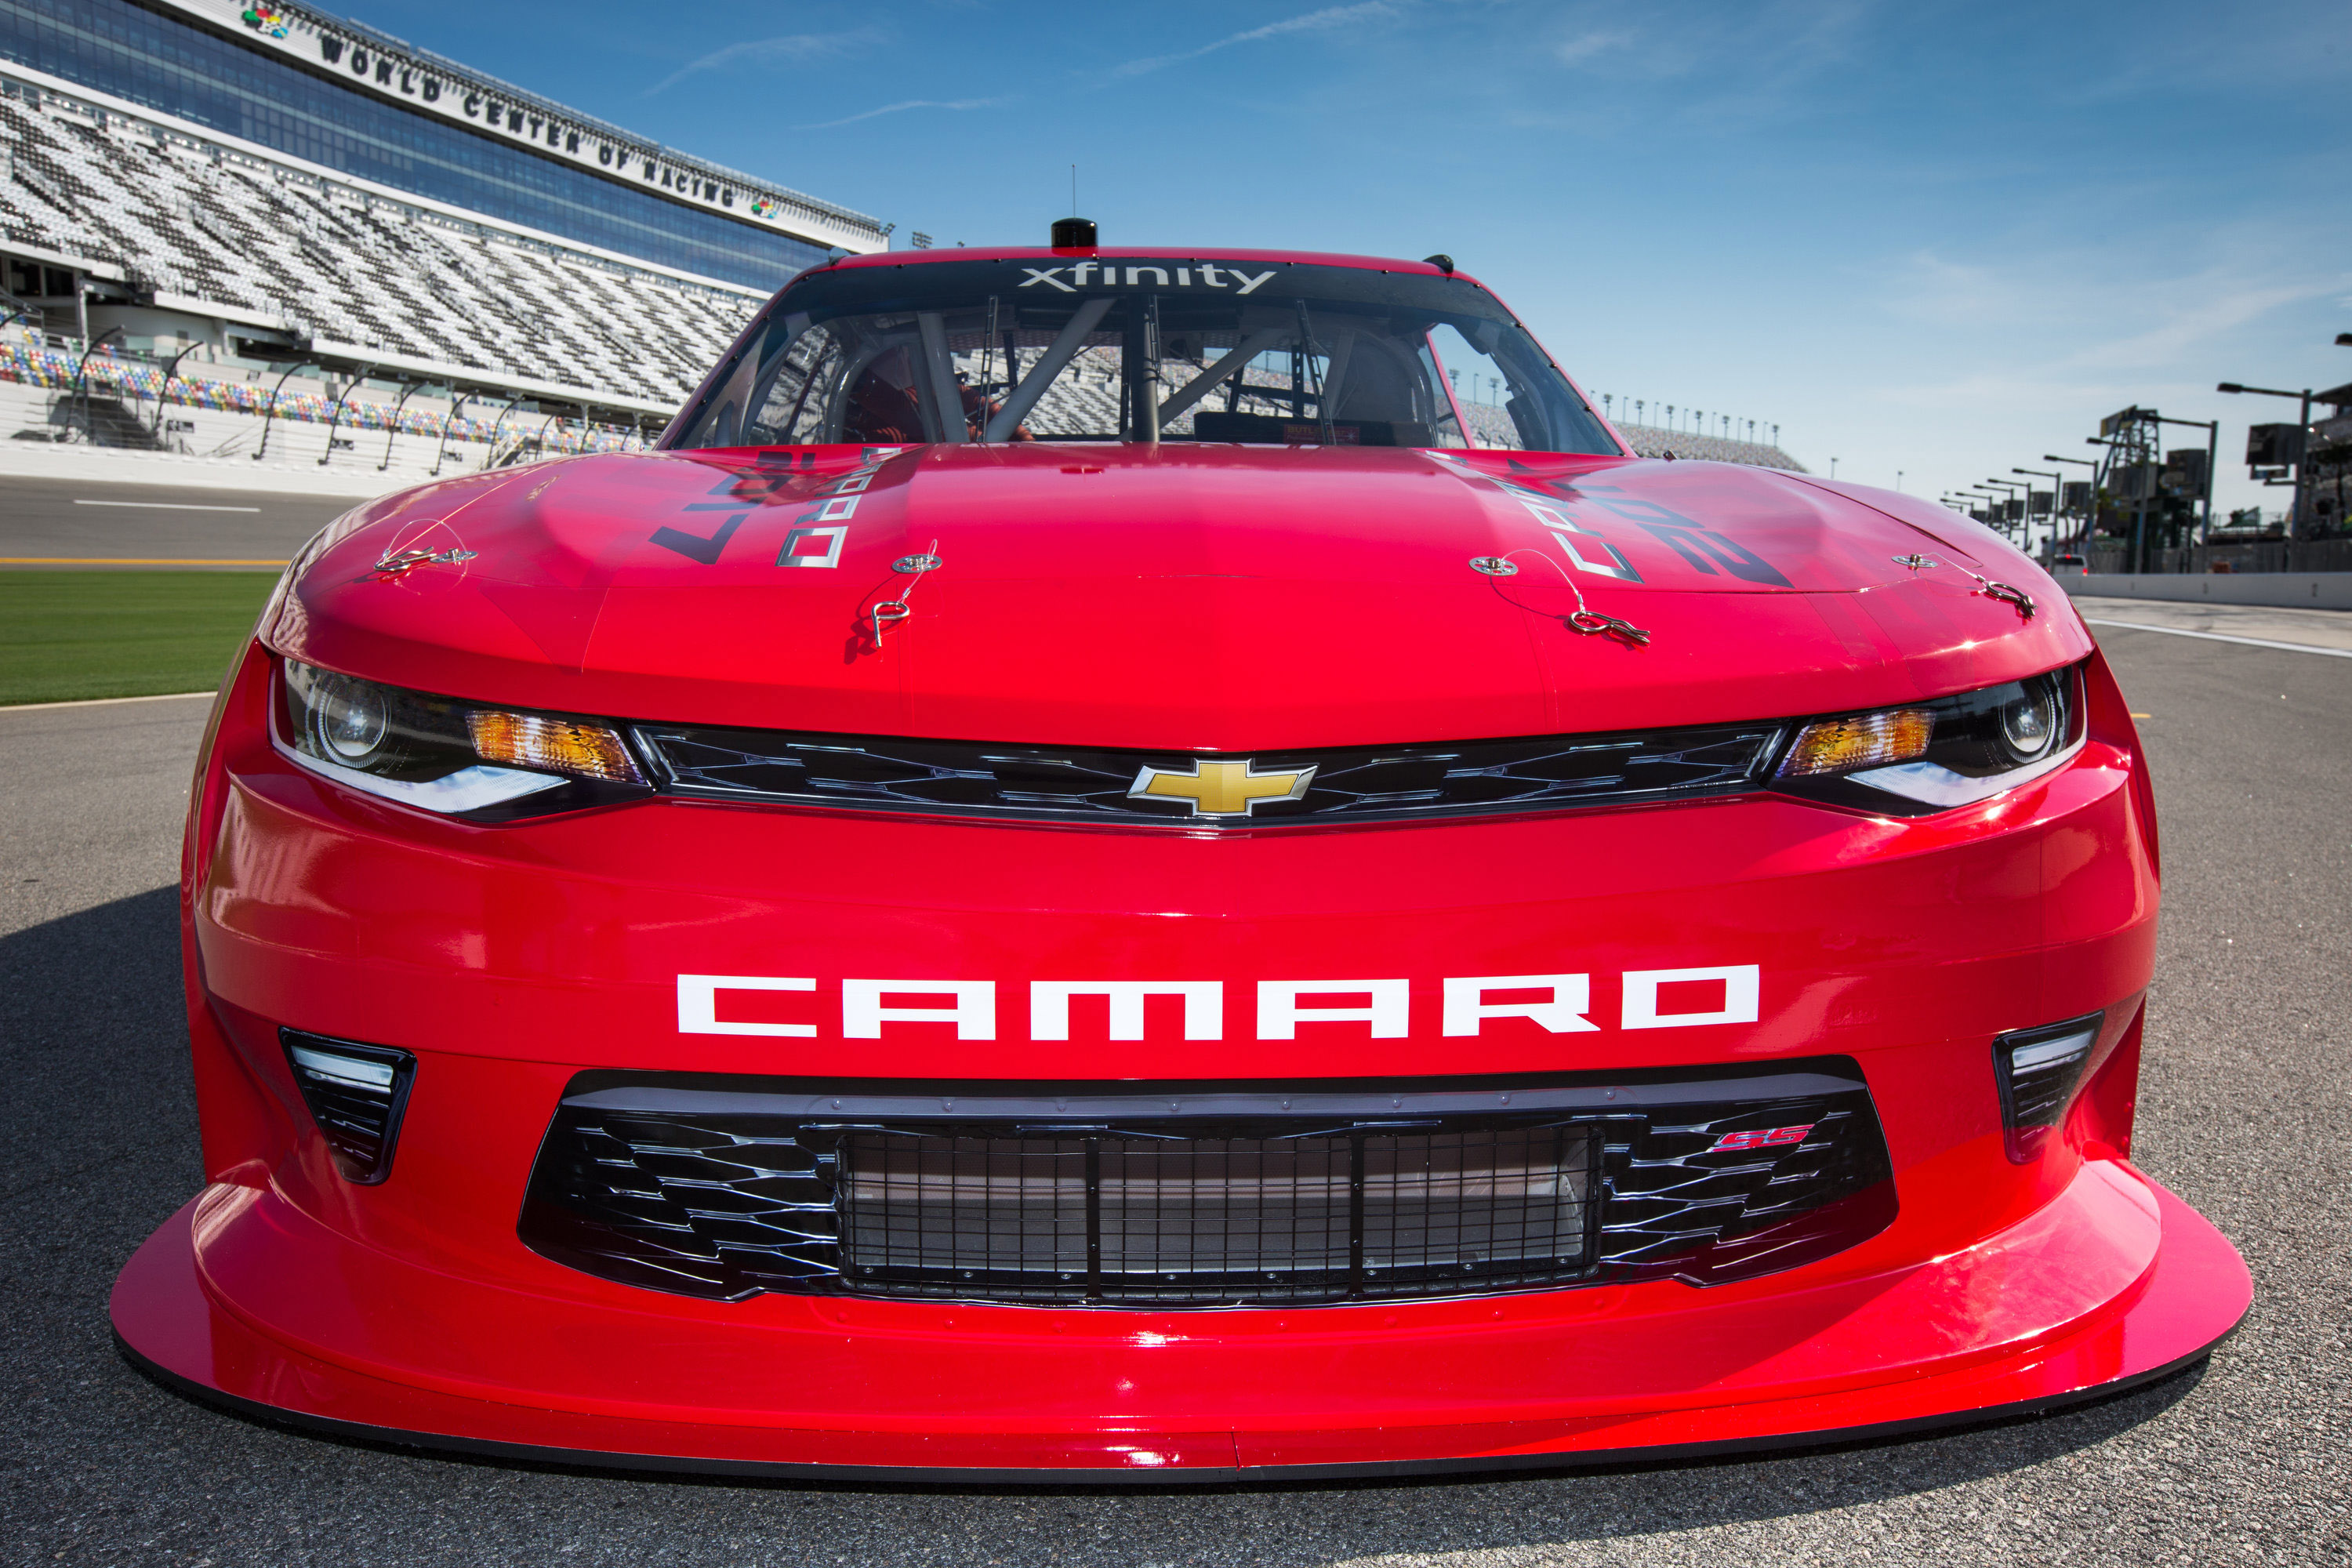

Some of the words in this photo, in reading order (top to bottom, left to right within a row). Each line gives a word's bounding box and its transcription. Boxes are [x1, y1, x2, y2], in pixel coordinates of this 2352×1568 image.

[321, 34, 442, 103] WORLD
[464, 92, 579, 154] CENTER
[598, 143, 630, 170] OF
[644, 157, 733, 207] RACING
[1017, 261, 1278, 295] xfinity
[677, 964, 1759, 1040] CAMARO
[1712, 1123, 1815, 1152] SS
